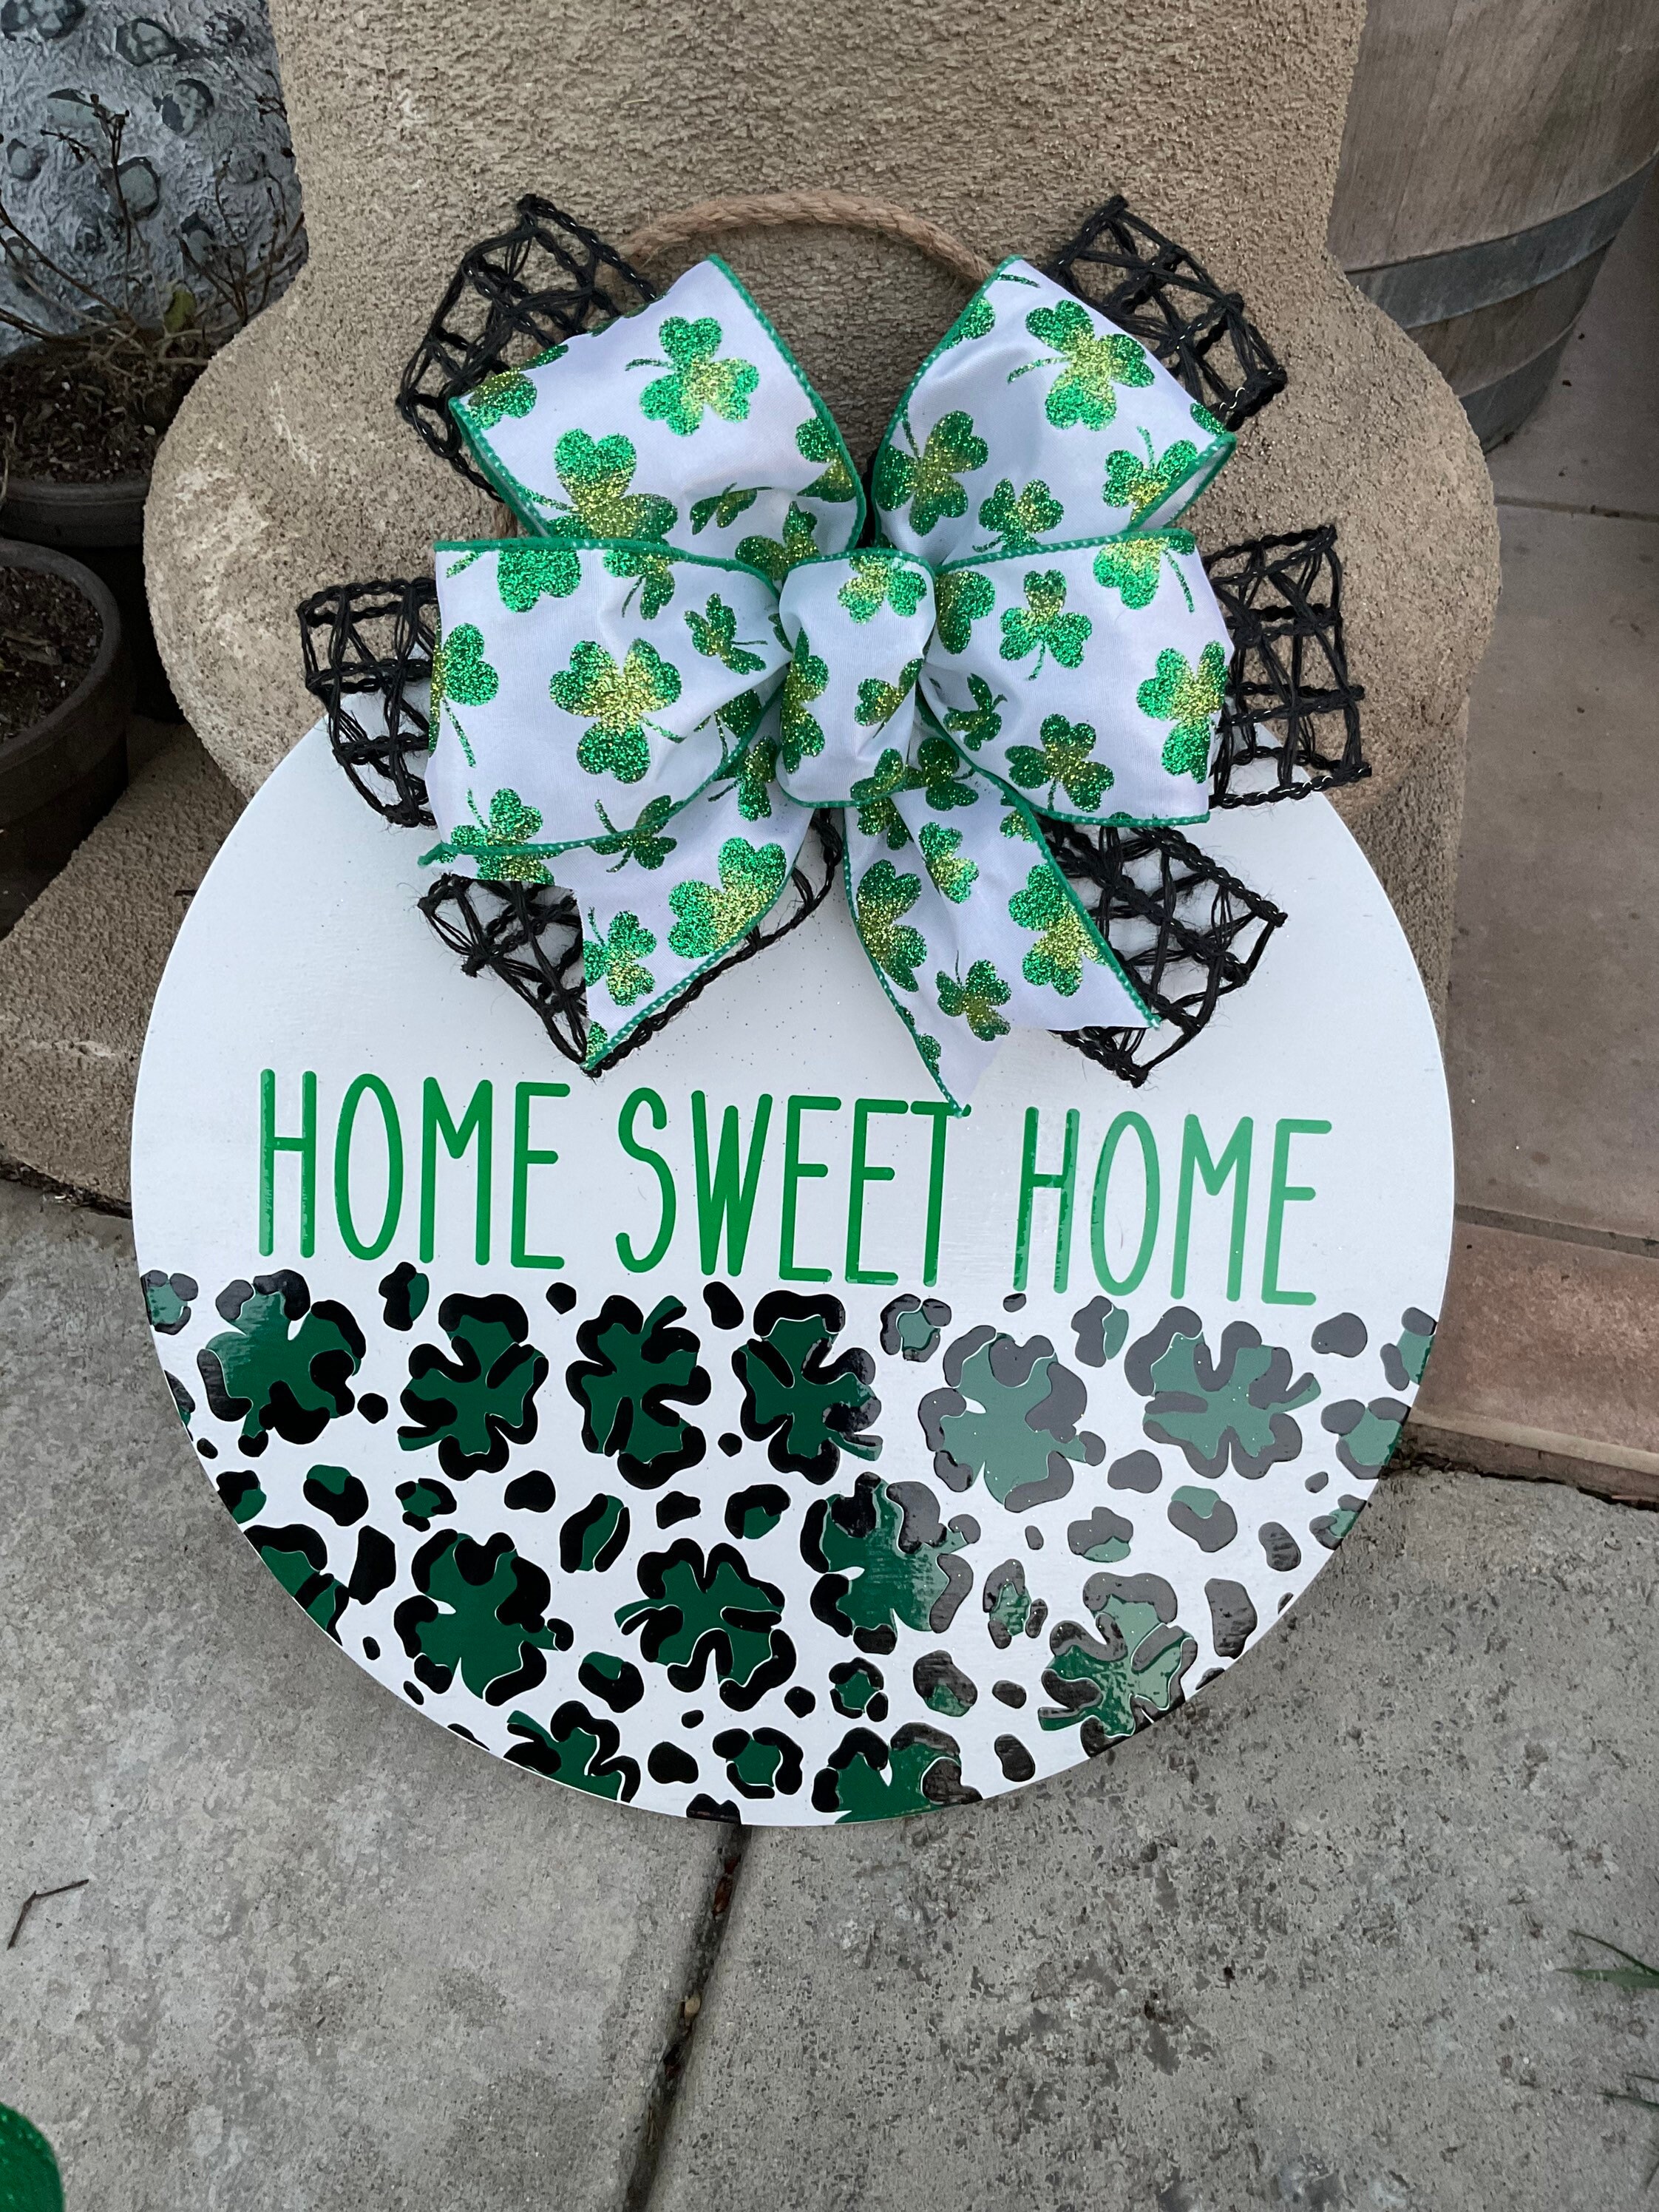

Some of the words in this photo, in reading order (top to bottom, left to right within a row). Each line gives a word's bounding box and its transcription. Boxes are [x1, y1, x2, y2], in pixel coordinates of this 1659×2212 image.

[259, 1069, 570, 1269] HOME
[615, 1088, 971, 1287] SWEET
[1014, 1107, 1331, 1305] HOME
